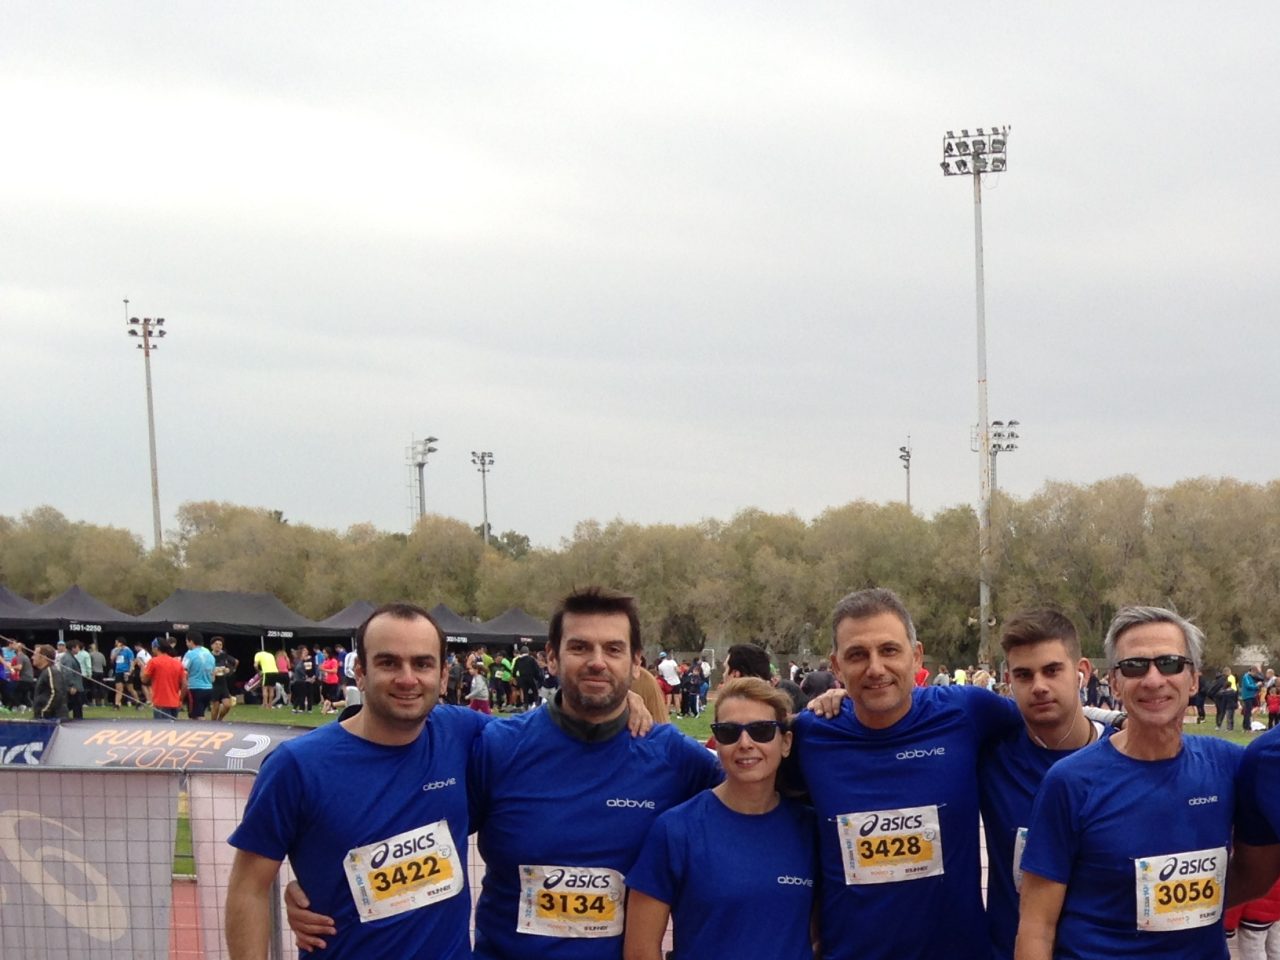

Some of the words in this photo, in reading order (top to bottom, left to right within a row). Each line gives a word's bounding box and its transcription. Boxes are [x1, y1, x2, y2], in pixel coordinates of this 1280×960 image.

[83, 730, 235, 750] RUNNER
[95, 747, 214, 769] STORE
[896, 747, 945, 760] abbvie
[423, 777, 456, 791] abbvie
[606, 798, 656, 809] abbvie
[880, 814, 922, 831] asics
[392, 832, 435, 859] asics
[860, 836, 922, 860] 3428
[373, 854, 441, 892] 3422
[1179, 856, 1217, 876] asics
[565, 873, 611, 889] asics
[1157, 880, 1215, 906] 3056
[540, 893, 606, 914] 3134
